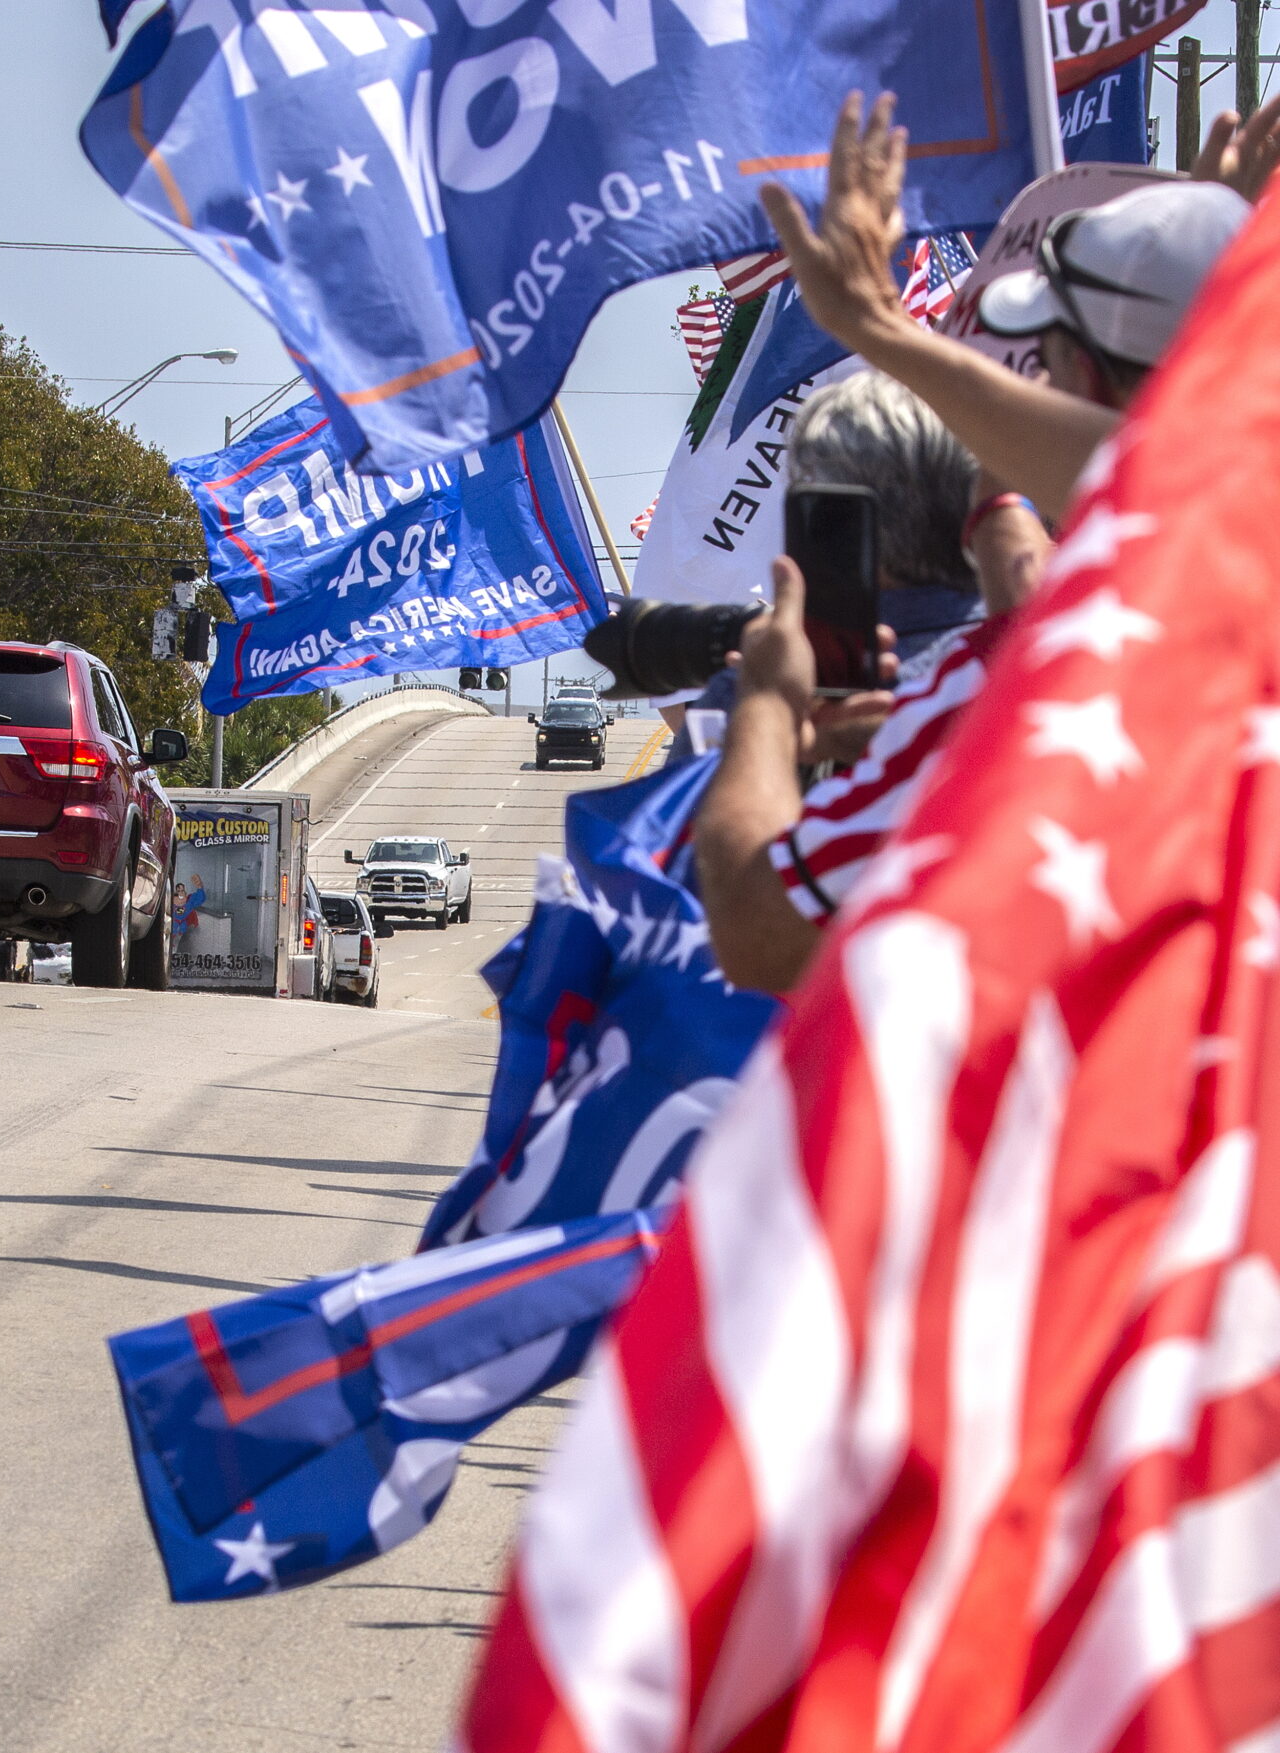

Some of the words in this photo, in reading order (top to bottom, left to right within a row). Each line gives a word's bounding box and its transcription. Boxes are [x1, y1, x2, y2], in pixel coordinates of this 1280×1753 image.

[175, 817, 214, 841] SUPER
[216, 818, 269, 836] CUSTOM
[195, 837, 224, 848] GLASS
[233, 834, 269, 843] MIRROR
[172, 953, 261, 970] 54-464-3516
